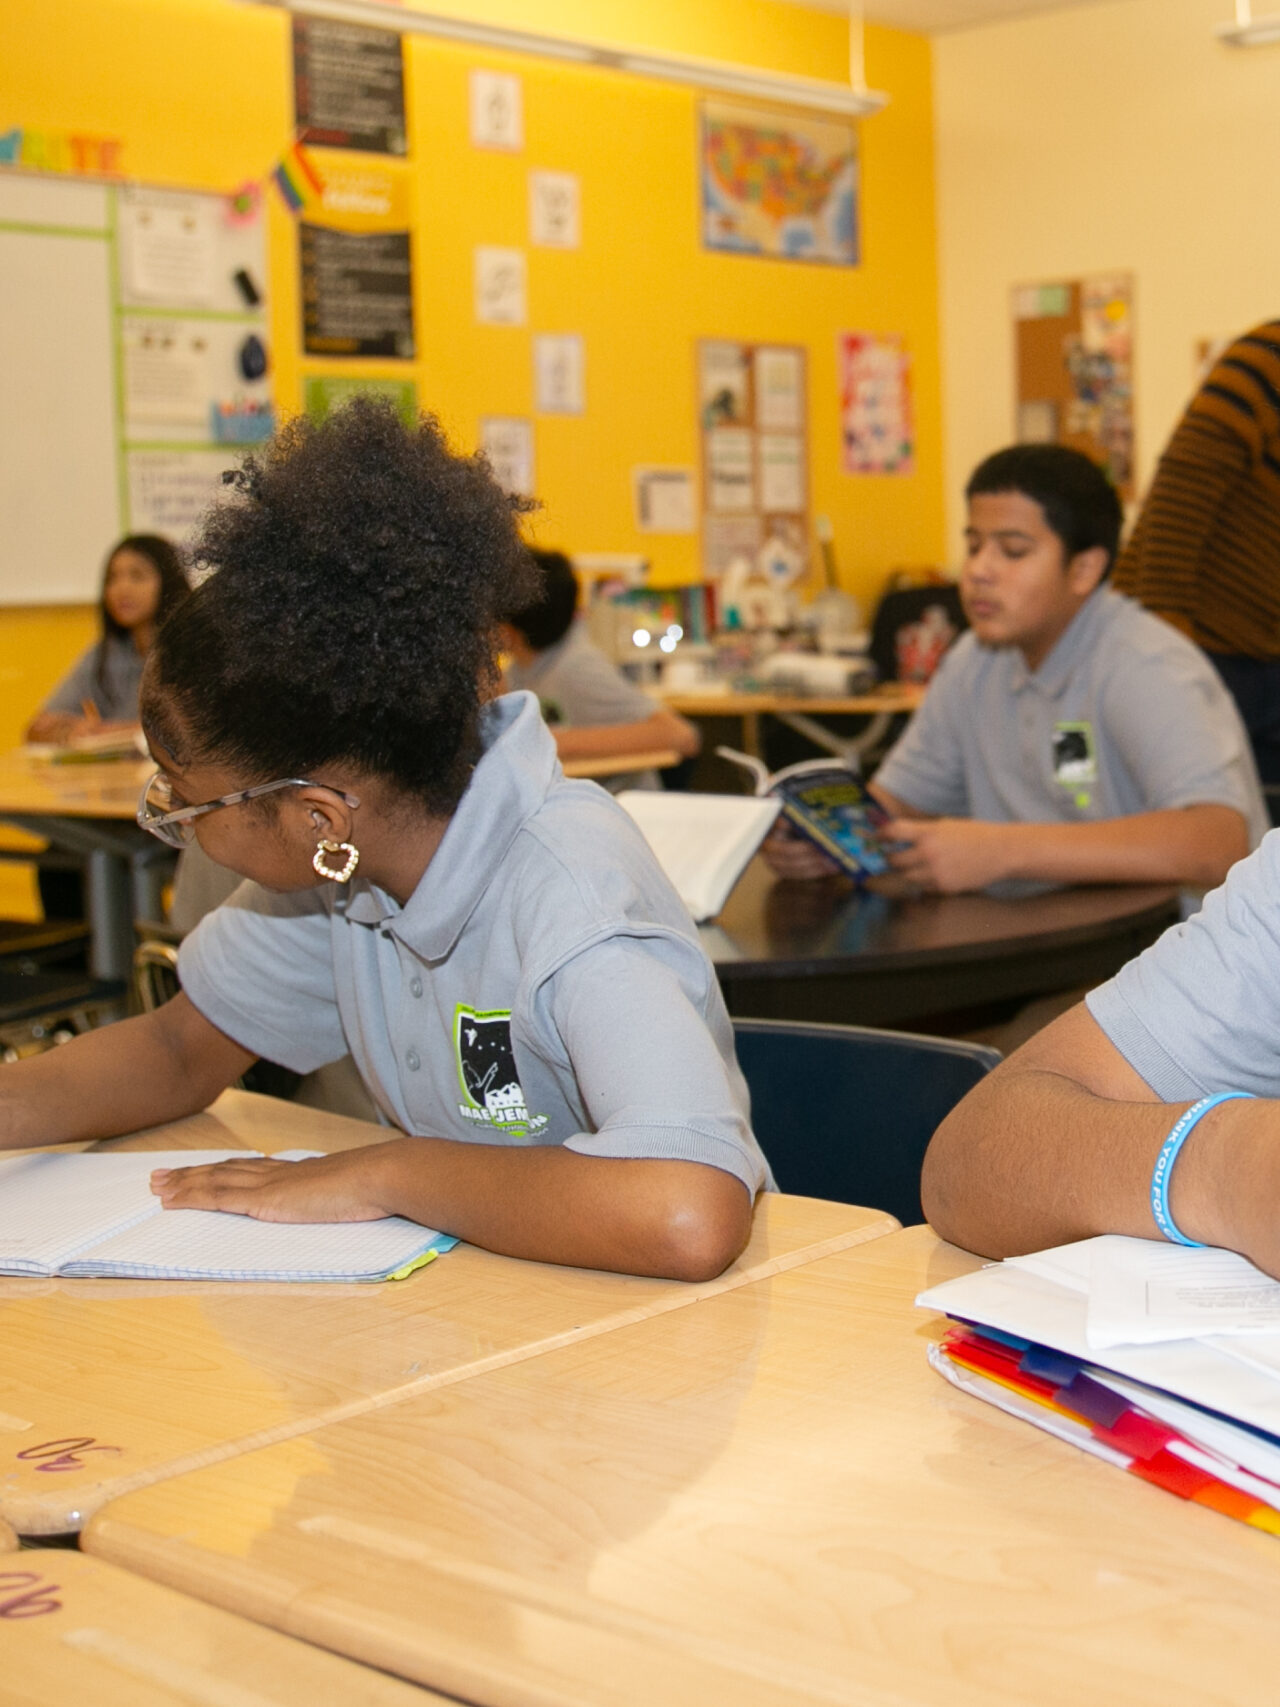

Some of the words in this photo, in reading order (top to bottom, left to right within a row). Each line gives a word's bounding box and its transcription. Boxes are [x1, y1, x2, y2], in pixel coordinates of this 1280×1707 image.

[459, 1105, 491, 1121] MAE
[1154, 1147, 1172, 1184] YOU
[1153, 1186, 1166, 1226] FOR
